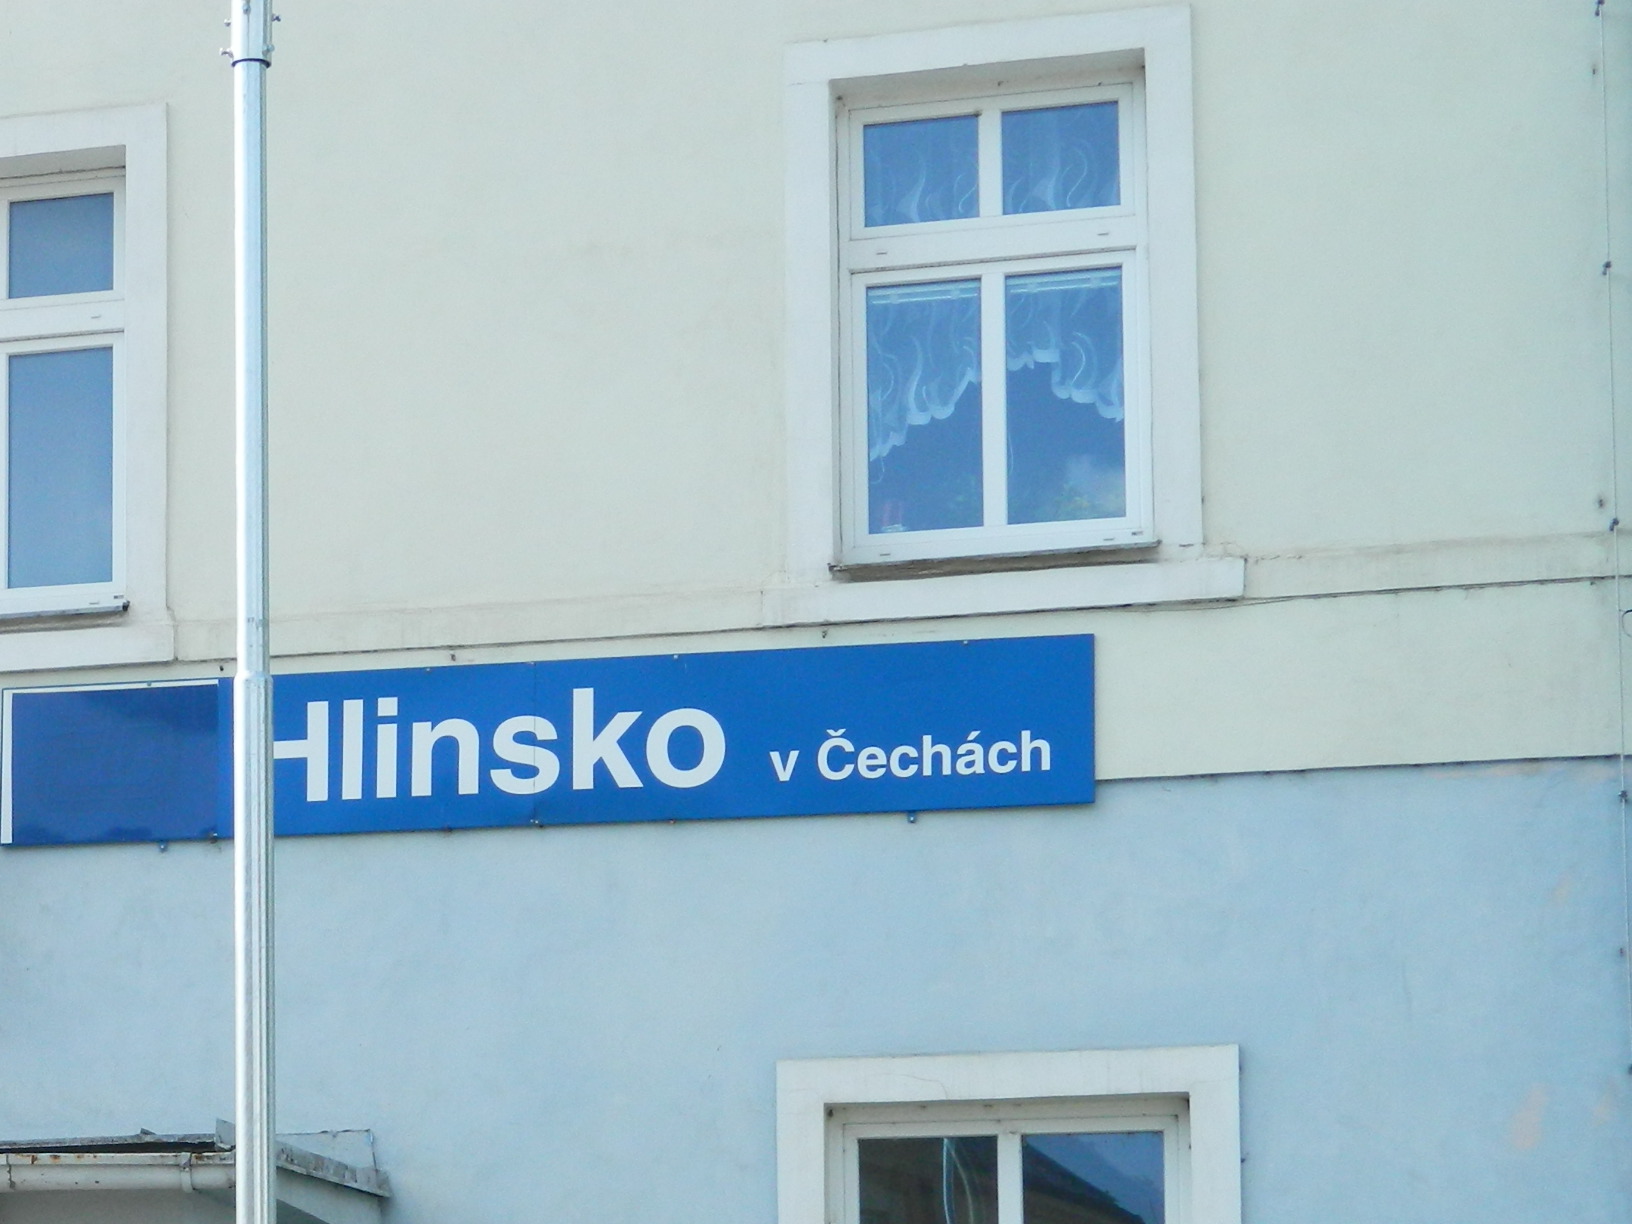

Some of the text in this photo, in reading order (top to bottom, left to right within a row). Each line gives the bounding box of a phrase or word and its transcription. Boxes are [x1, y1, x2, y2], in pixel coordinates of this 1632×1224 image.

[273, 687, 1051, 802] Hlinsko v Čechách
